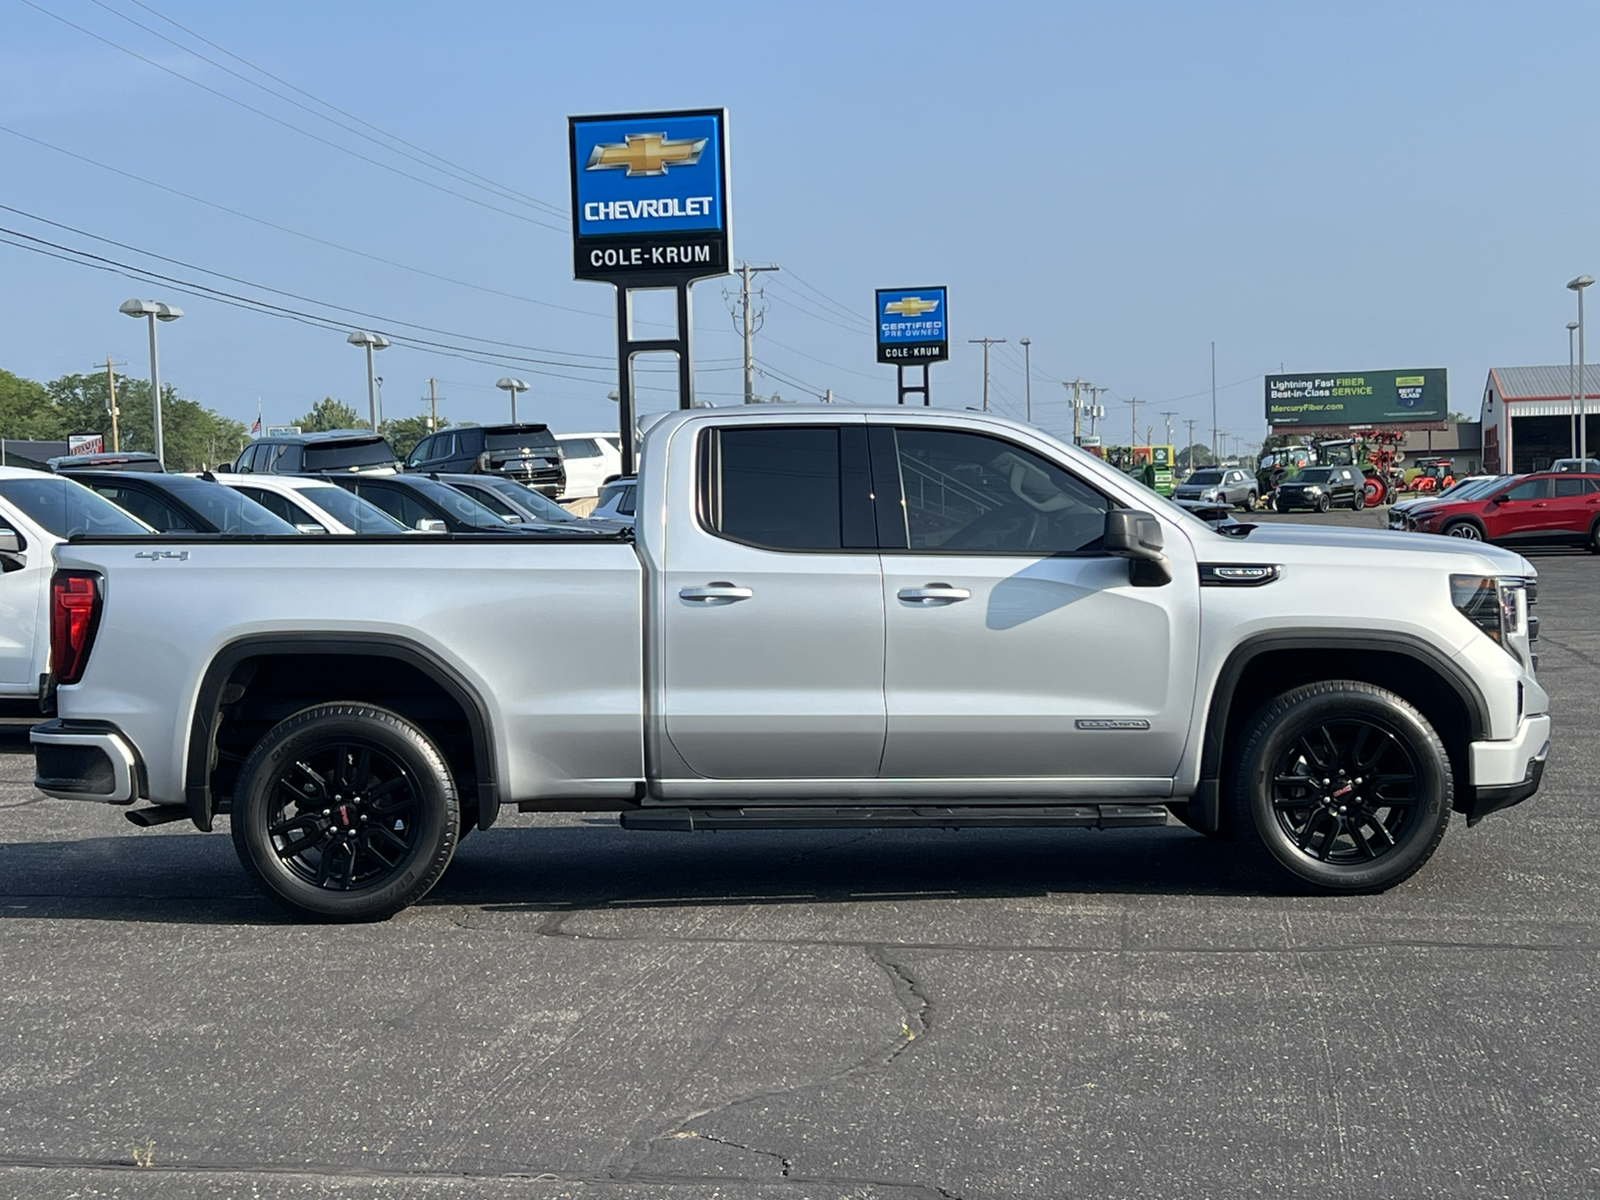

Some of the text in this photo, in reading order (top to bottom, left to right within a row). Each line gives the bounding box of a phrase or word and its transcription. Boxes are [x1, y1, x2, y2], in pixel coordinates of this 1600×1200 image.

[585, 196, 713, 221] CHEVROLET
[590, 245, 711, 267] COLE-KRUM
[882, 321, 942, 330] CERTIFIED
[884, 328, 940, 337] PRE-OWNED
[885, 346, 940, 358] COLE-KRUM
[1270, 377, 1365, 391] Lightning Fast FIBER
[1271, 386, 1373, 399] Best-in-Class SERVICE
[1271, 403, 1344, 413] MercuryFiber.com
